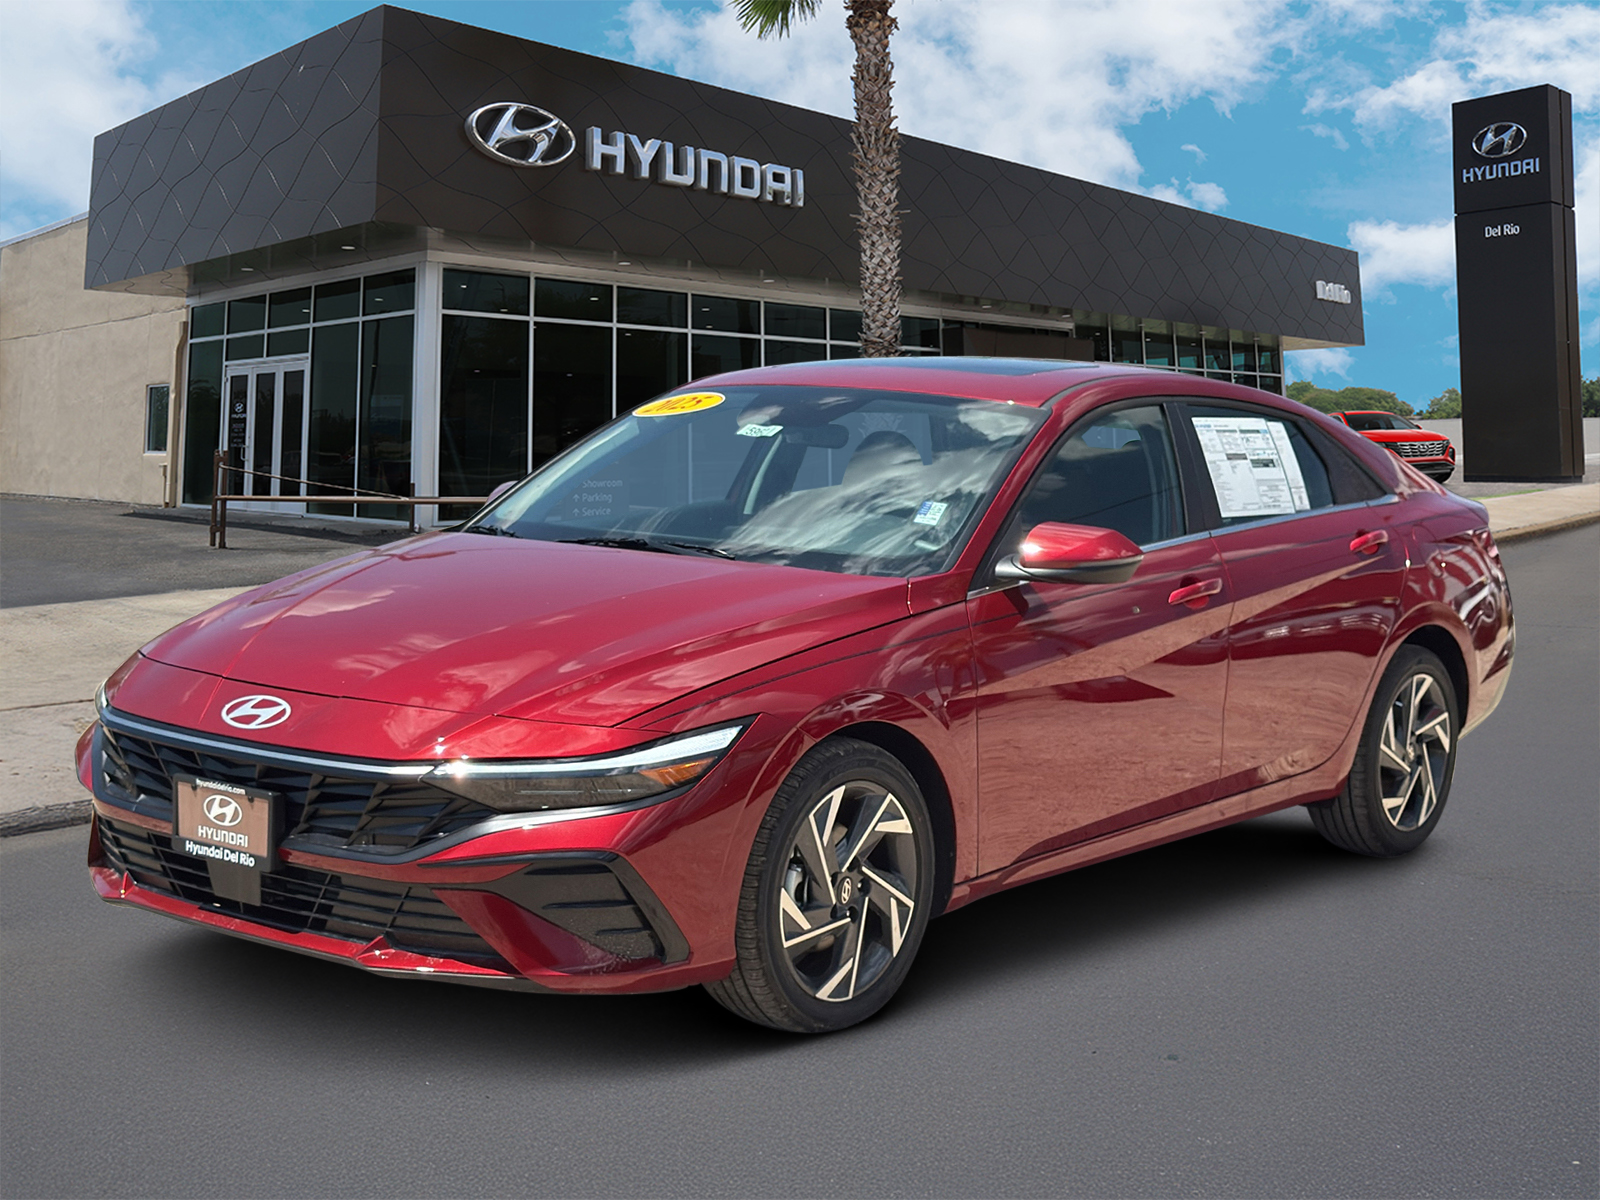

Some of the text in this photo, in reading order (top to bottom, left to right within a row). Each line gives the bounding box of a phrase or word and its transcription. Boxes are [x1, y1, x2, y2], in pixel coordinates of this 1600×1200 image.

[586, 126, 804, 207] HYUNDAI
[1462, 157, 1540, 183] HYUNDAI
[1484, 223, 1520, 238] Del Rio
[582, 493, 612, 503] Parking
[582, 507, 611, 516] Service
[198, 825, 248, 848] HYUNDAI
[185, 840, 255, 867] Hyundai Del Rio
